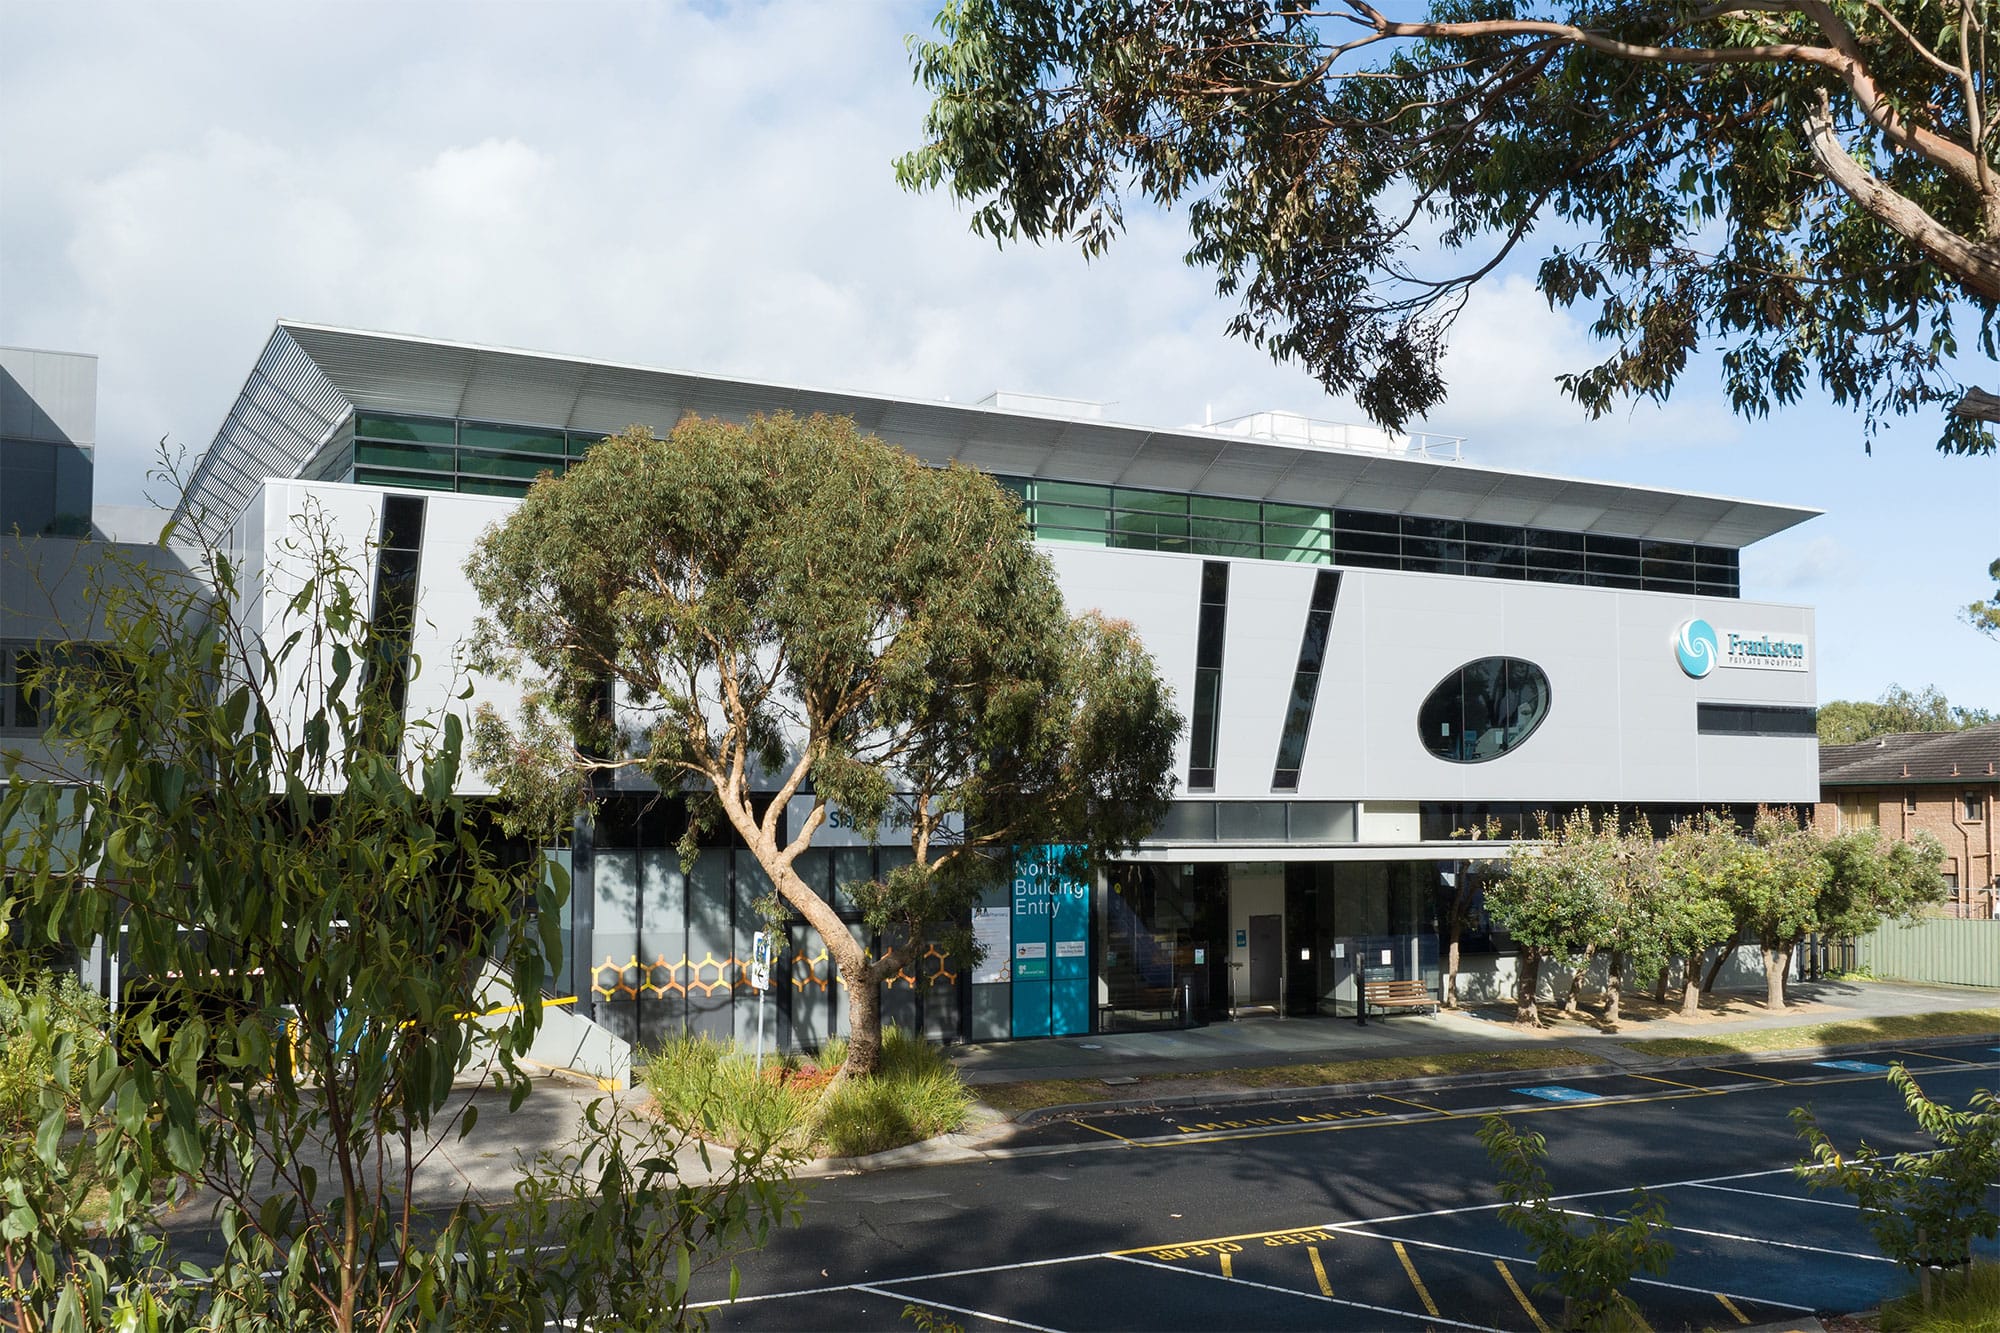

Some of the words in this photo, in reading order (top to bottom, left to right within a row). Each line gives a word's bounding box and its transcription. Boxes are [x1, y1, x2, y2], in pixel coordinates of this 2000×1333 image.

[1728, 633, 1803, 659] Frankston
[1729, 657, 1761, 665] PRIVATE
[1764, 659, 1802, 667] HOSPITAL
[1015, 898, 1060, 918] Entry
[1177, 1108, 1388, 1133] AMBULANCE
[1263, 1230, 1336, 1247] KEEP
[1151, 1241, 1244, 1261] CLEAR
